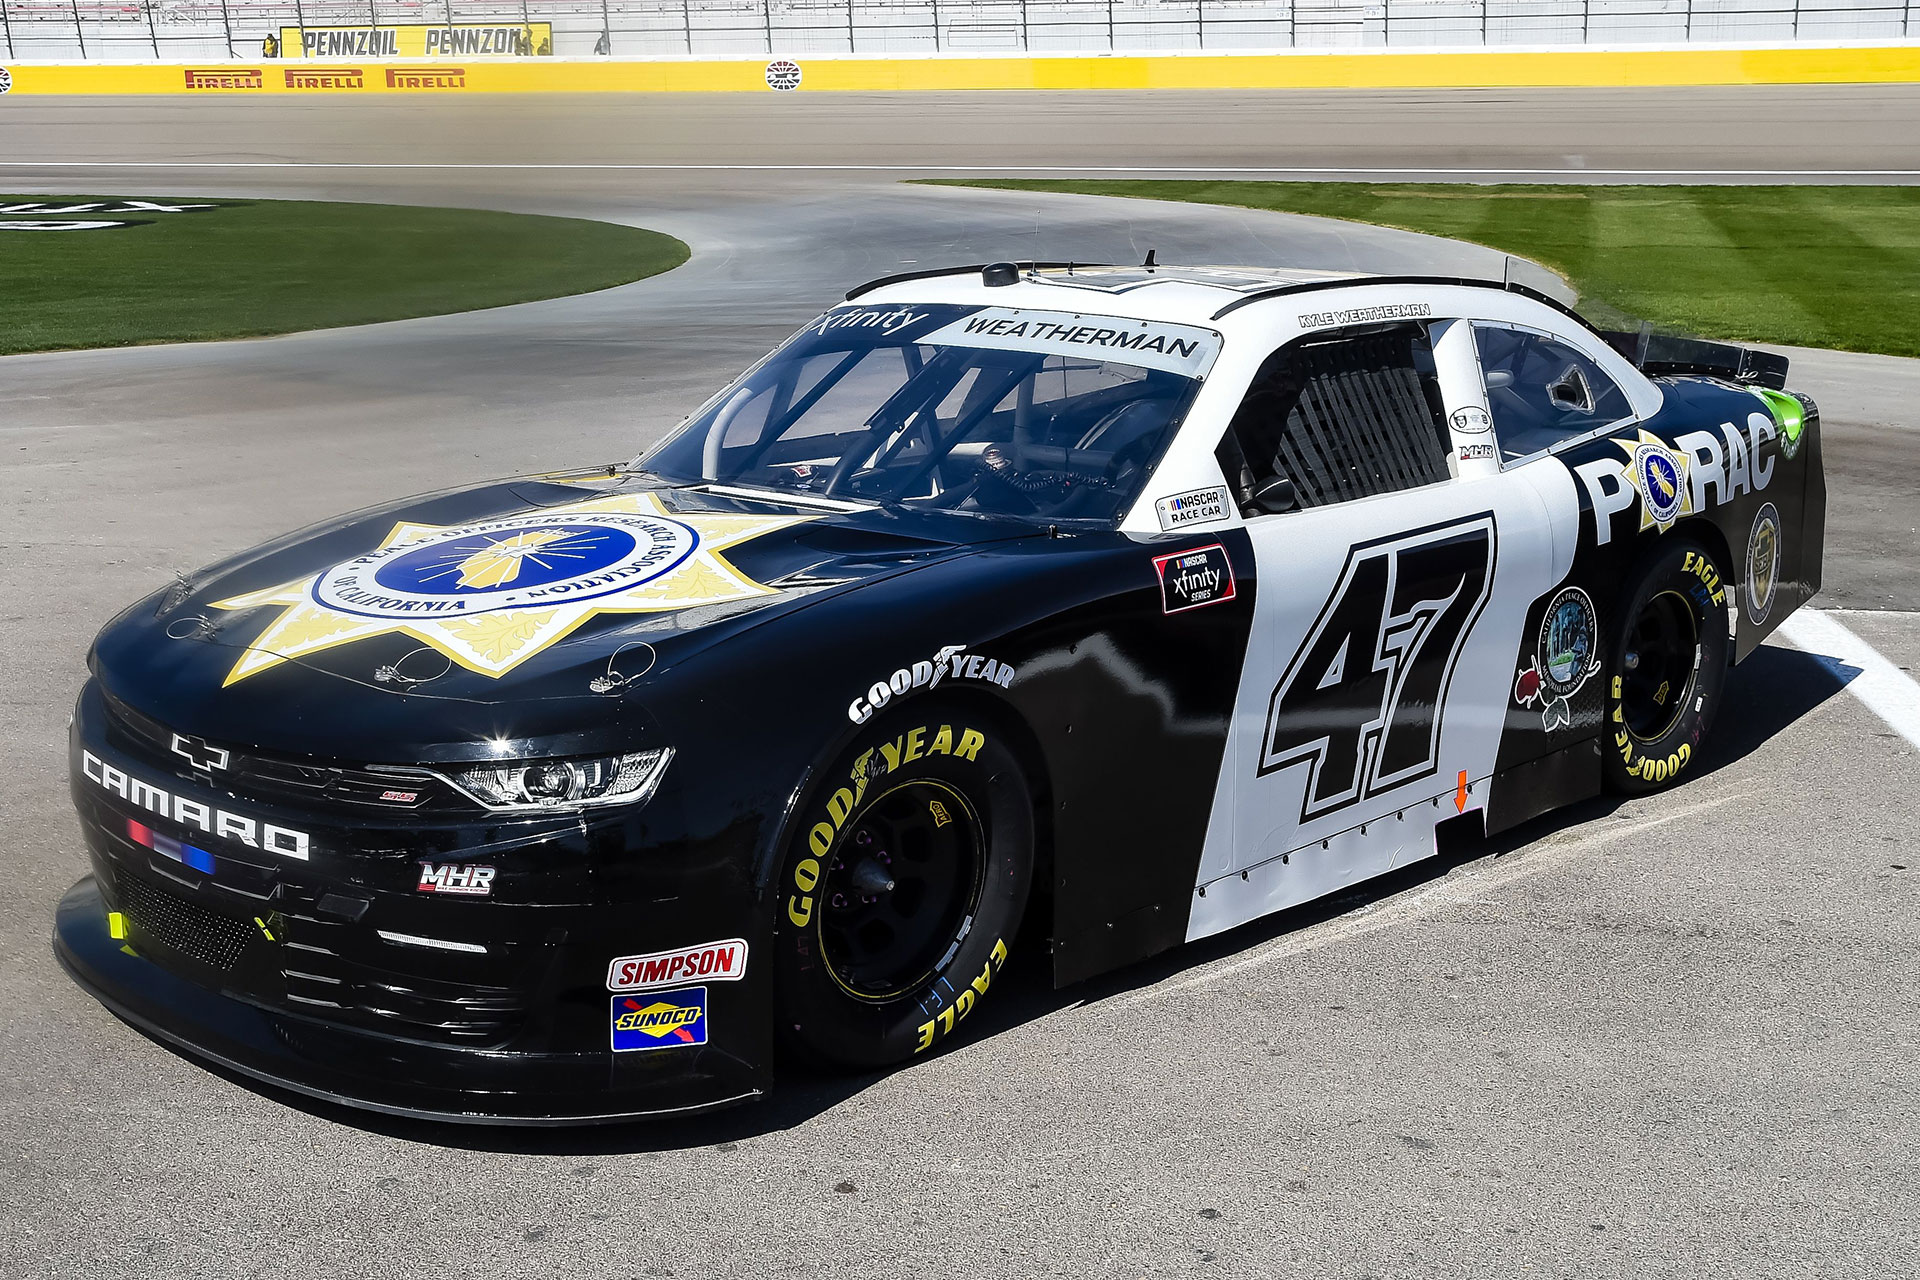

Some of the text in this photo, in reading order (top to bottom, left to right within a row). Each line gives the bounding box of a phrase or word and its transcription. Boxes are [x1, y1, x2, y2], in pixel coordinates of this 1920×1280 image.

[305, 30, 399, 56] PENNZOIL
[185, 69, 263, 88] PIRELLI
[285, 69, 363, 88] PIRELLI
[386, 68, 466, 88] PIRELLI
[811, 307, 930, 337] xfinity
[1298, 303, 1431, 328] KYLE WEATHERMAN
[964, 316, 1200, 359] WEATHERMAN
[1459, 445, 1493, 460] MHR
[1171, 505, 1221, 523] RACE CAR
[1179, 491, 1220, 510] NASCAR
[358, 515, 676, 599] PEACE OFFICERS RESEARCH ASSOCIATION
[1183, 553, 1208, 568] NASCAR
[1173, 566, 1220, 598] xfinity
[1681, 551, 1726, 608] EAGLE
[333, 576, 466, 612] OF CALIFORNIA
[1191, 589, 1211, 602] SERIES
[1255, 510, 1498, 826] 47
[848, 644, 1015, 725] GOODYEAR
[83, 749, 310, 862] CAMARO
[788, 724, 986, 927] GOODYEAR
[420, 863, 496, 889] MHR
[618, 946, 735, 985] SIMPSON
[914, 938, 1008, 1054] EAGLE
[618, 1007, 699, 1029] SUNOCO
